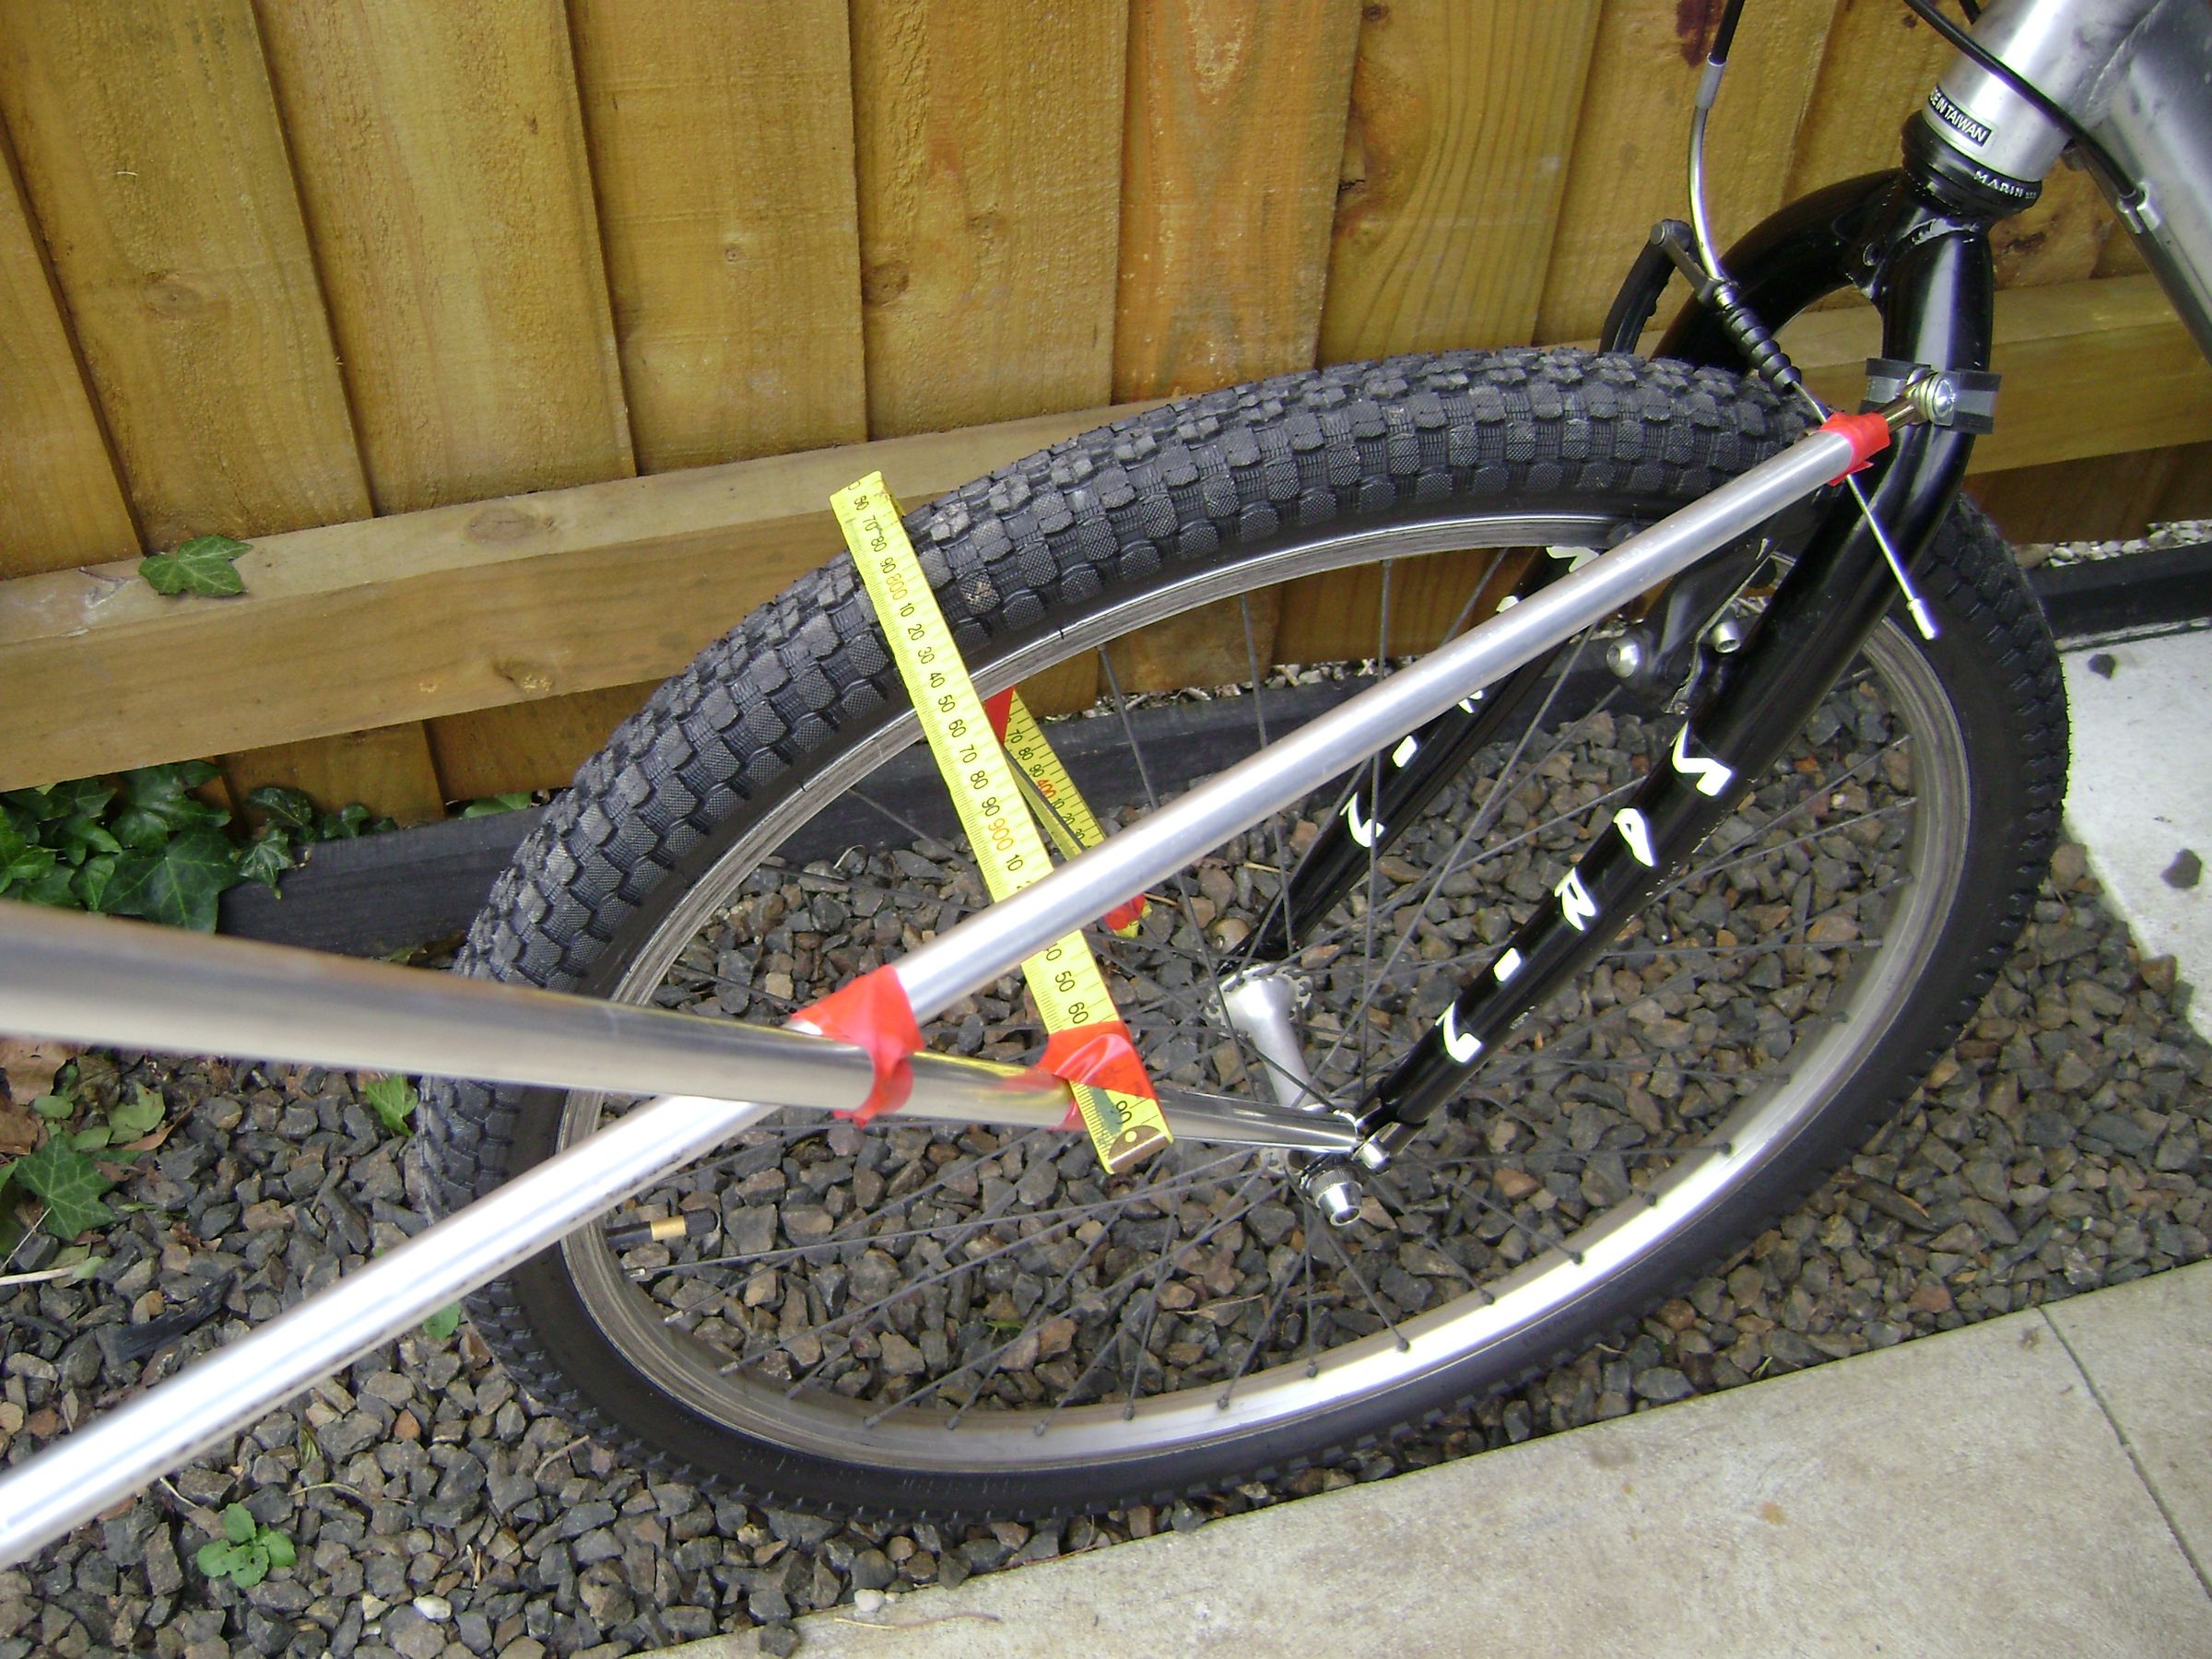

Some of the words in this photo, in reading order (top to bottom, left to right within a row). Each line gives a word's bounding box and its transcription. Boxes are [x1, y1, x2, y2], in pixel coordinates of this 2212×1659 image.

[1936, 97, 1947, 113] IN
[1945, 104, 1987, 143] TAIWAN
[1973, 171, 2024, 197] MARIN
[863, 514, 877, 531] 70
[871, 535, 887, 552] 80
[879, 557, 896, 574] 90
[886, 574, 908, 600] 800
[899, 602, 915, 617] 10
[907, 623, 925, 641] 20
[917, 646, 935, 664] 30
[929, 671, 945, 688] 40
[937, 694, 956, 712] 50
[947, 719, 967, 737] 60
[1008, 729, 1023, 744] 70
[959, 744, 977, 763] 70
[1018, 747, 1034, 761] 80
[1030, 763, 1045, 778] 90
[970, 770, 989, 790] 80
[1036, 779, 1057, 799] 400
[982, 796, 1000, 817] 90
[1052, 797, 1065, 810] 10
[1063, 813, 1076, 826] 20
[987, 818, 1015, 851] 900
[1006, 853, 1024, 872] 10
[1054, 971, 1076, 993] 50
[1068, 1002, 1089, 1025] 60
[1110, 1100, 1133, 1125] 90
